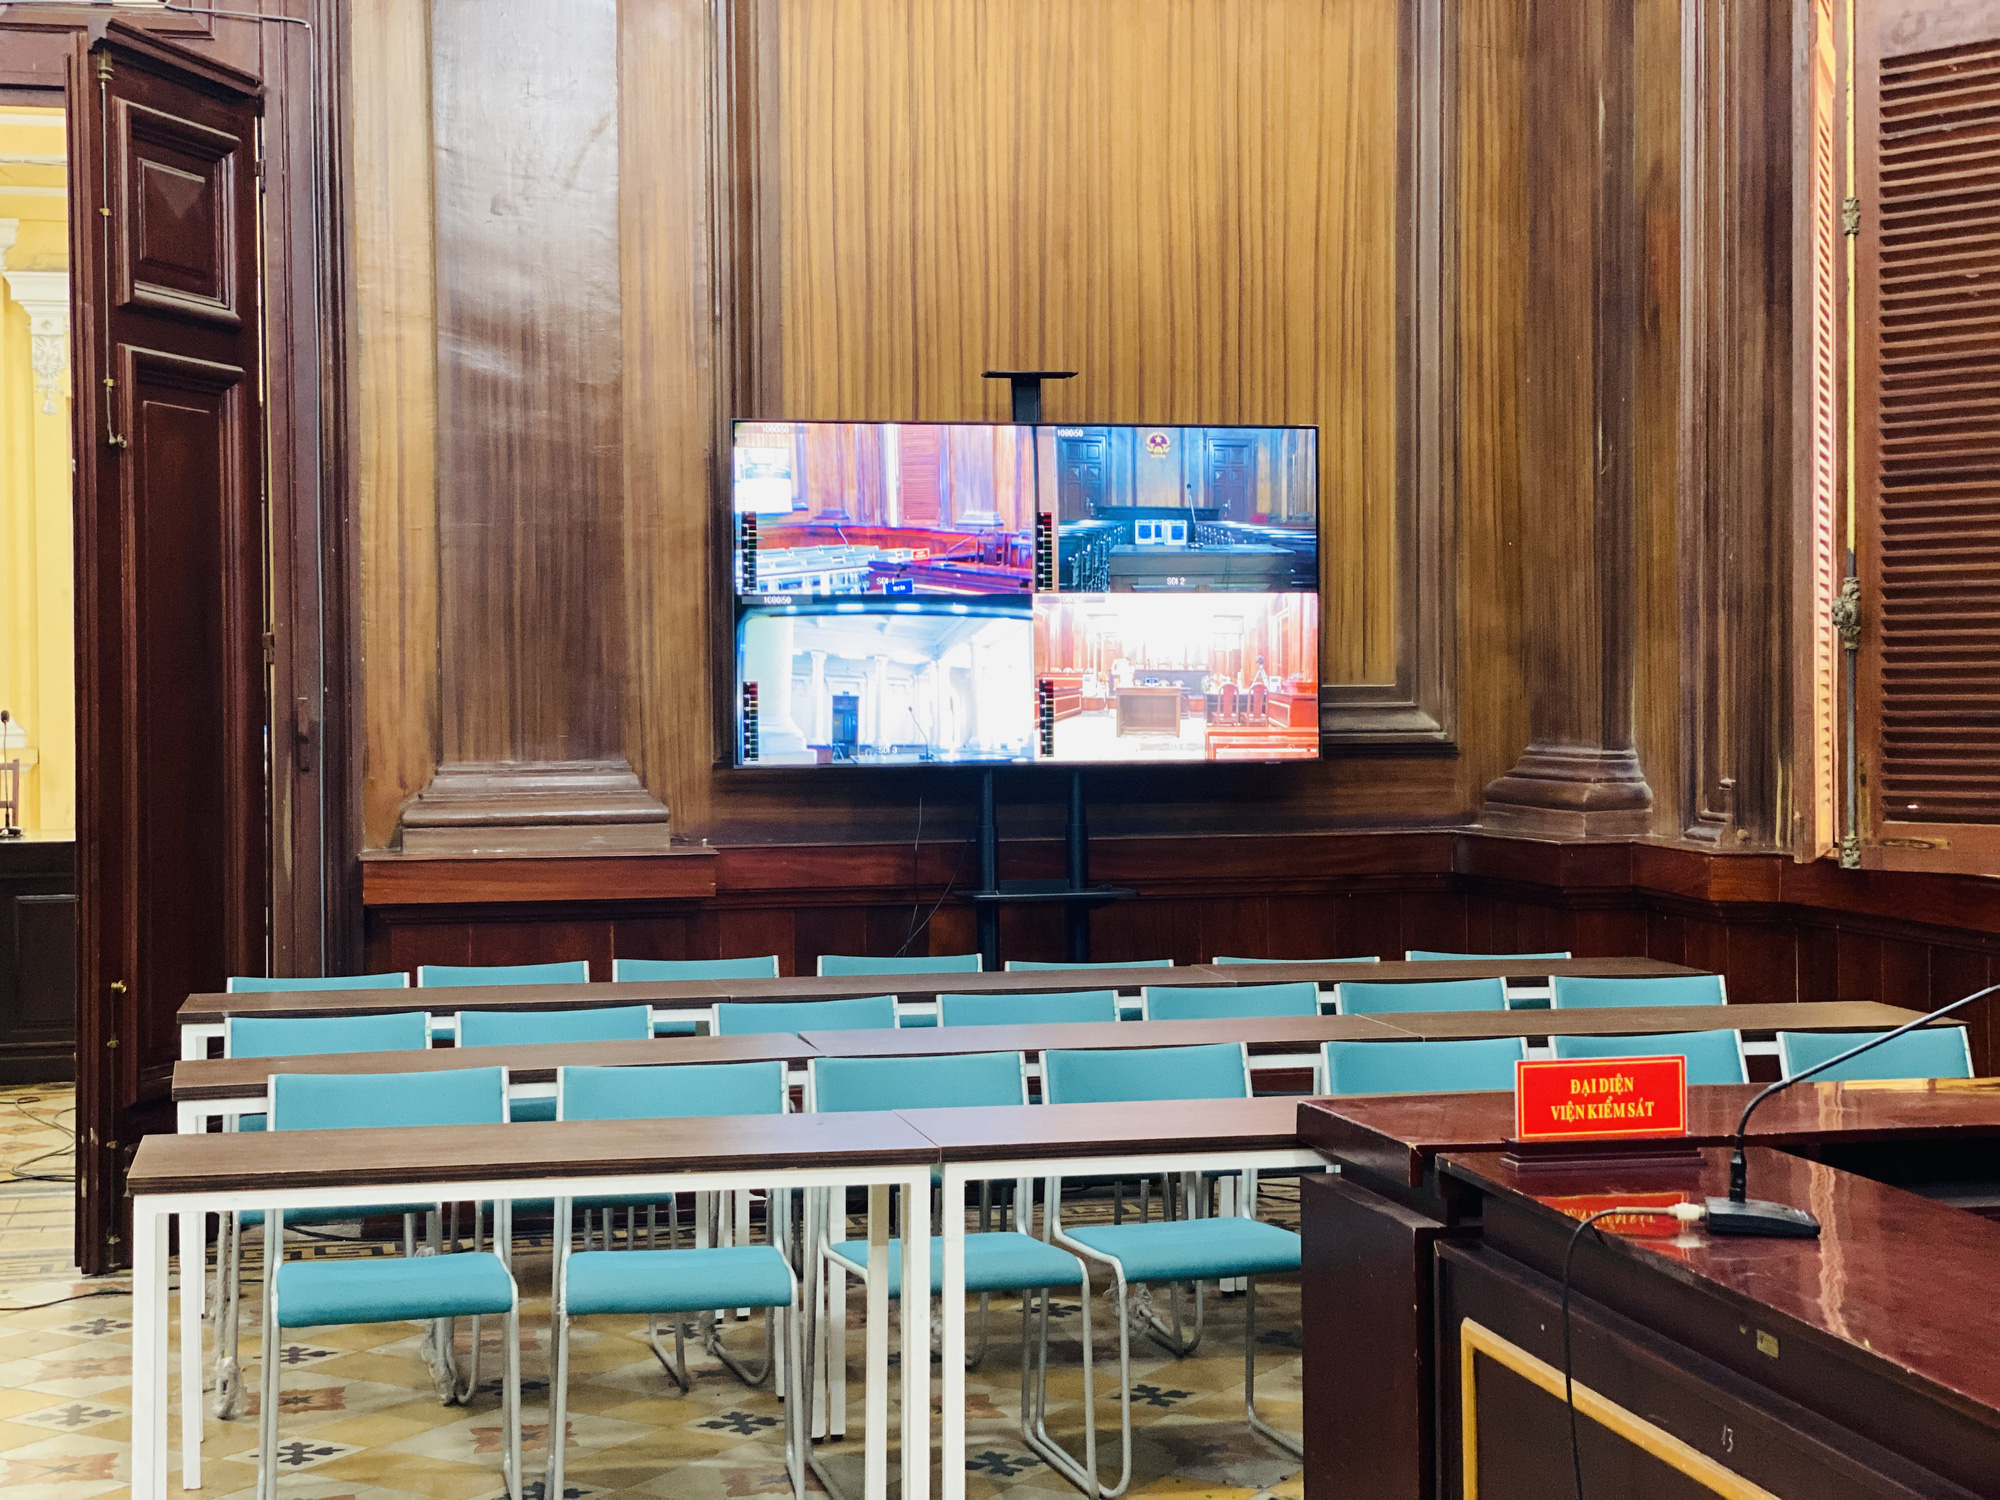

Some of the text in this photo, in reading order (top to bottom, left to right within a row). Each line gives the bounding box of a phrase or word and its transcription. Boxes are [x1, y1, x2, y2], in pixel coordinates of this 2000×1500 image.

[1180, 576, 1186, 586] 2
[1570, 1072, 1634, 1097] ĐẠI DIỆN
[1550, 1095, 1655, 1123] VIỆN KIỂM SÁT
